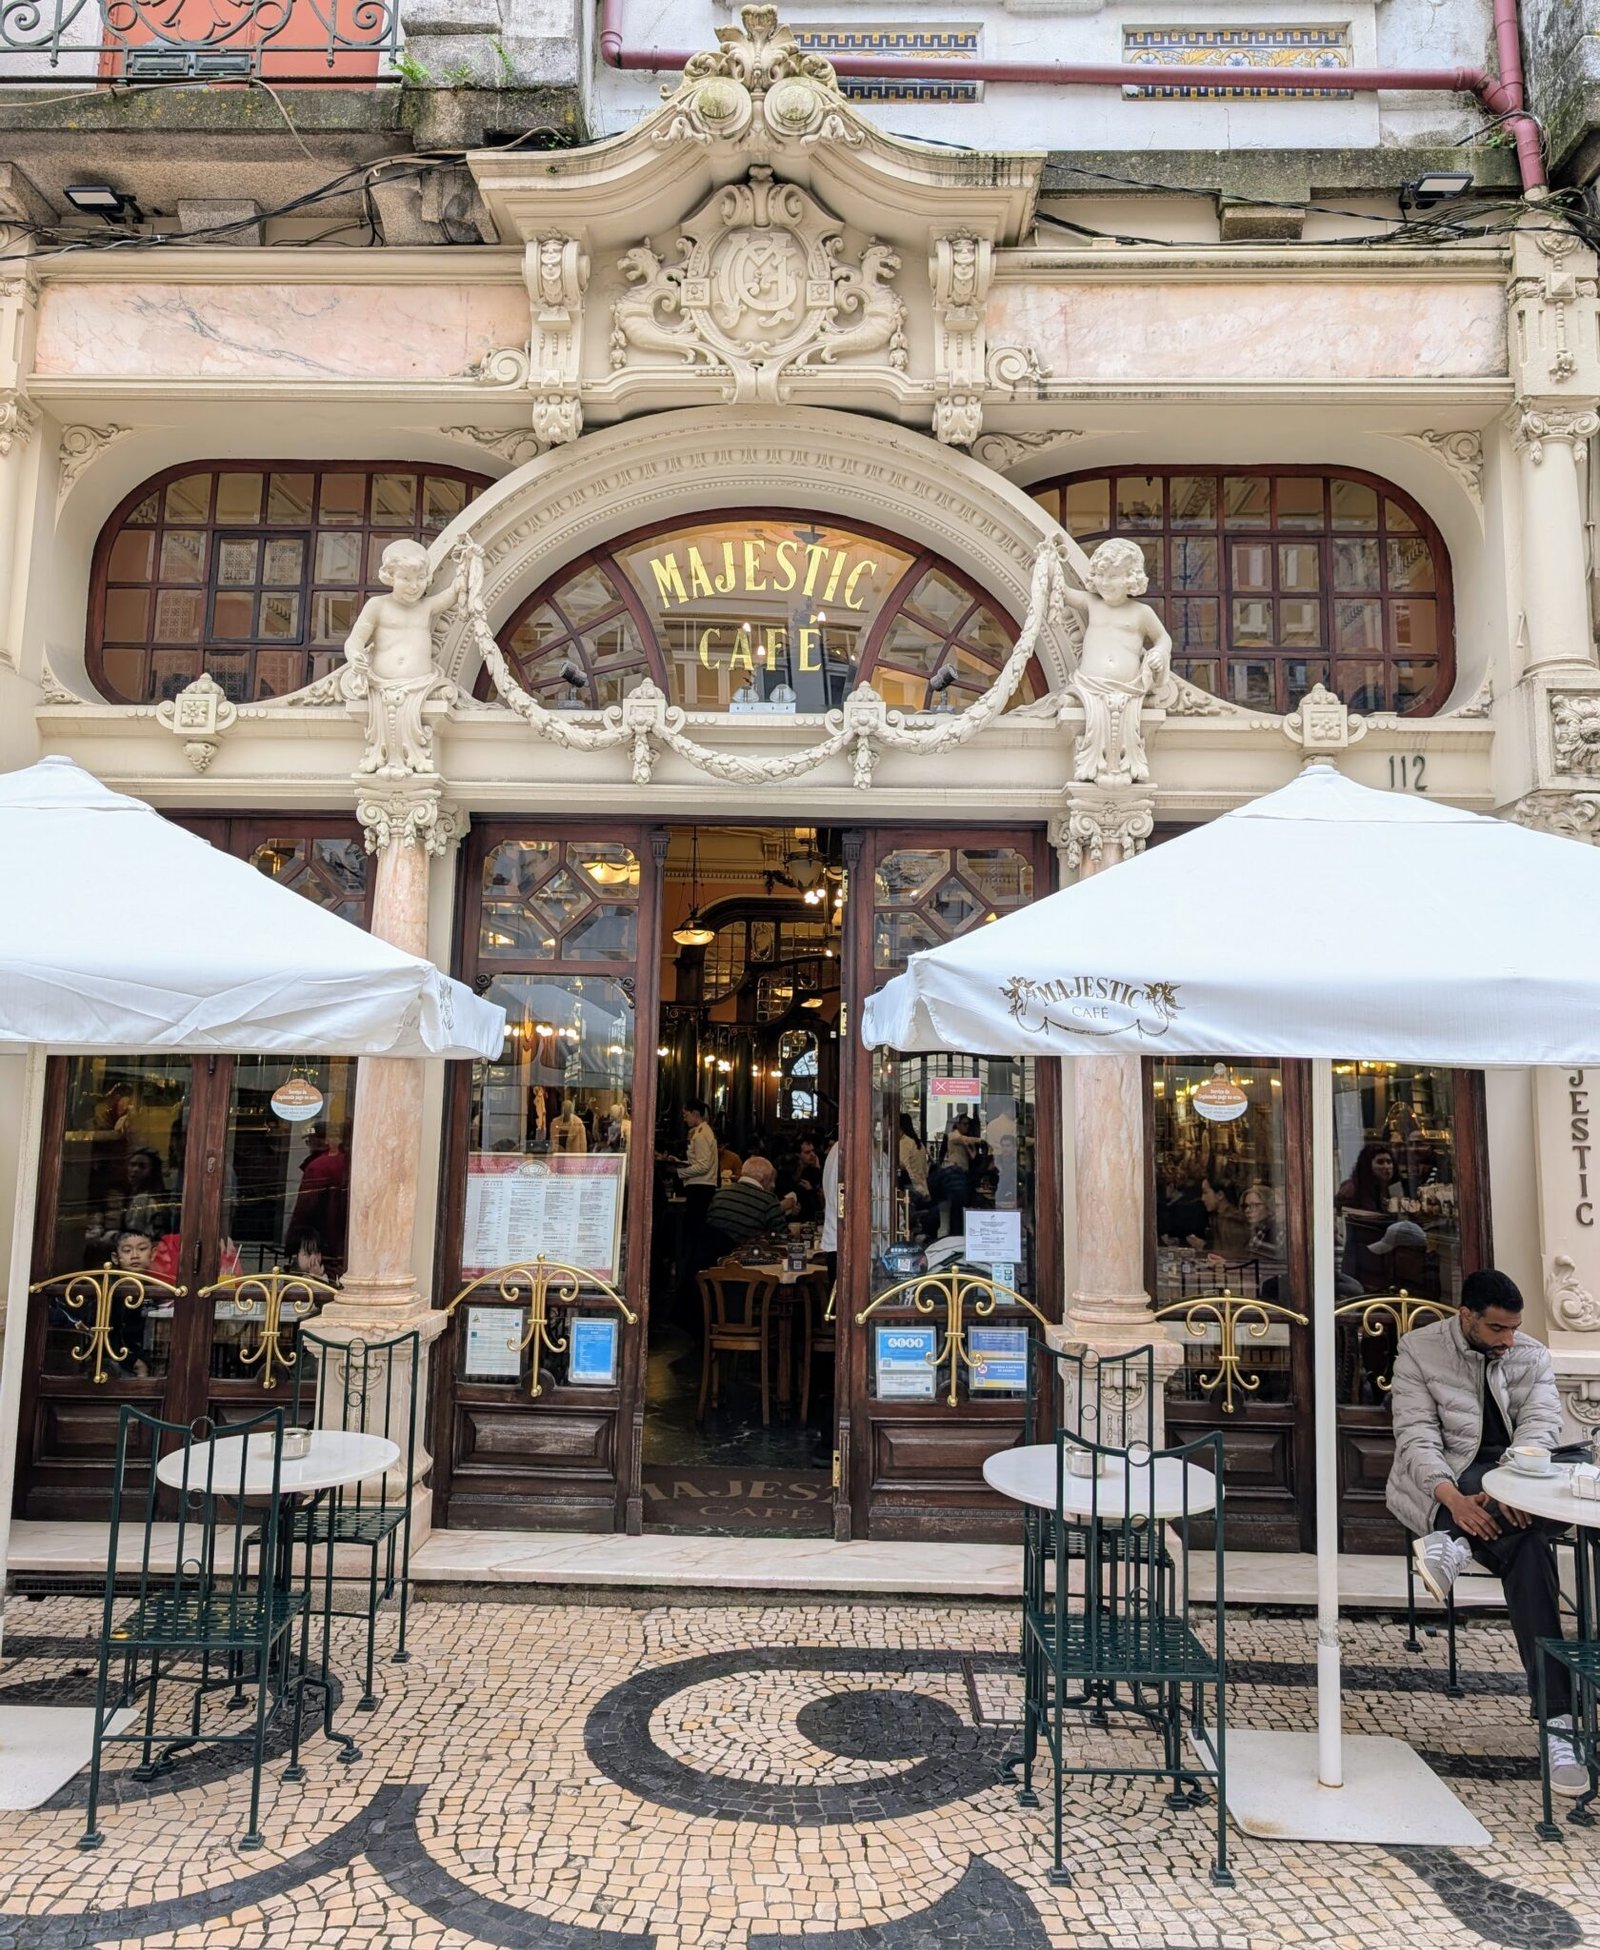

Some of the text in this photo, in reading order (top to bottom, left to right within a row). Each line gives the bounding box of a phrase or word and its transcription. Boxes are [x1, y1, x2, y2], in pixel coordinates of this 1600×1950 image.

[650, 539, 878, 610] MAJESTIC
[699, 614, 822, 671] CAFÉ
[1388, 755, 1428, 792] 112
[1036, 976, 1144, 1010] MAJESTIC
[1071, 1006, 1109, 1020] CAFÉ
[700, 1506, 816, 1520] CAFÉ
